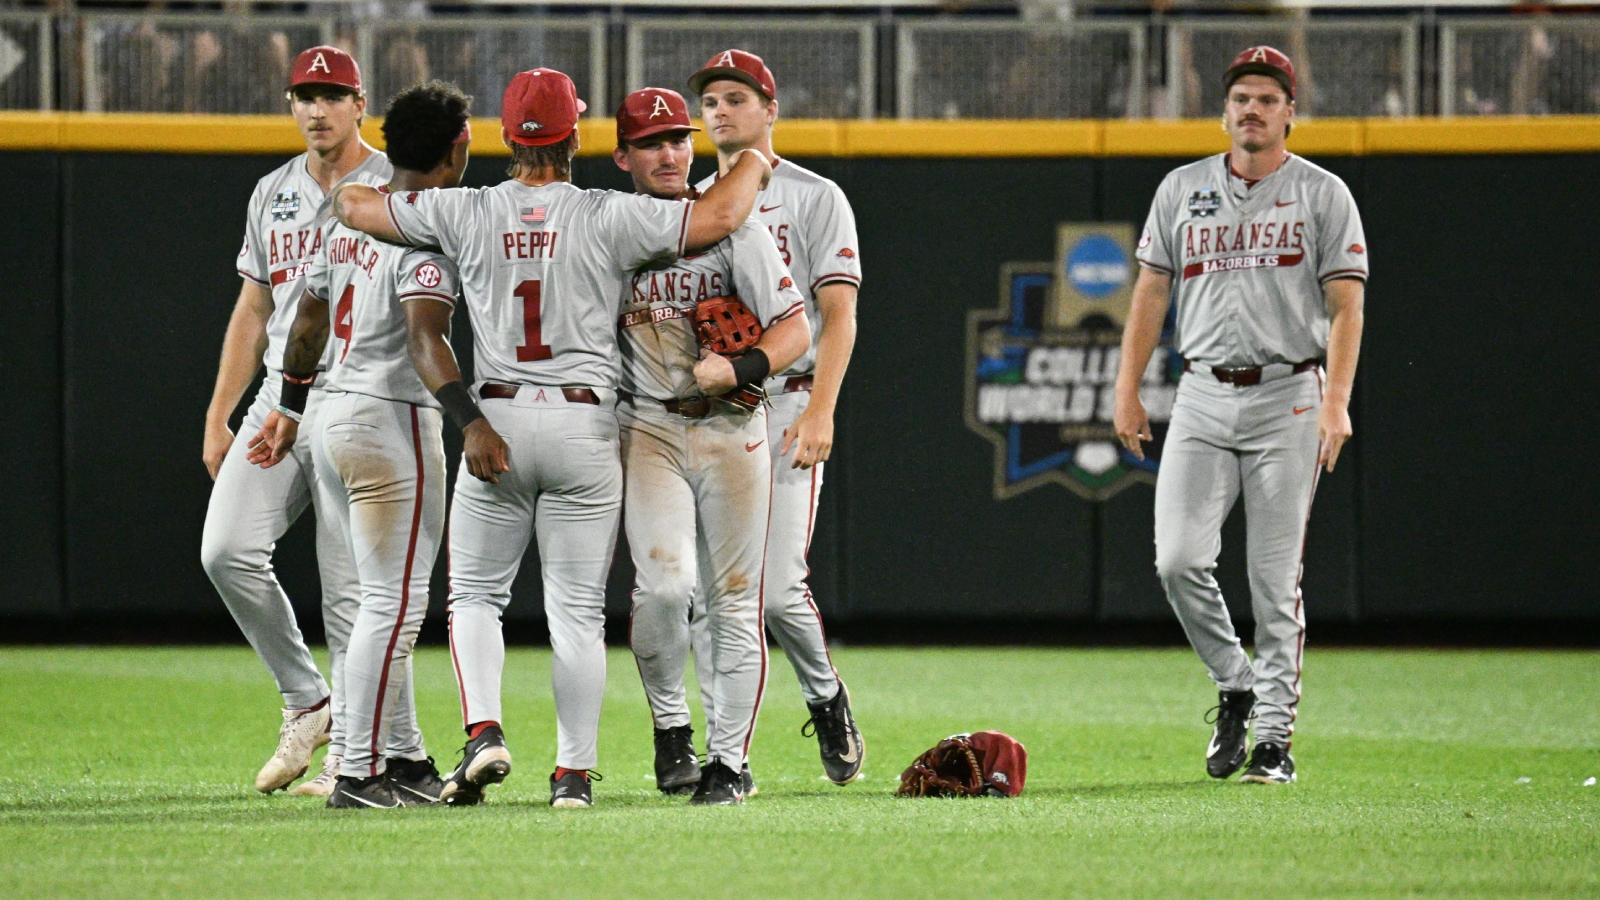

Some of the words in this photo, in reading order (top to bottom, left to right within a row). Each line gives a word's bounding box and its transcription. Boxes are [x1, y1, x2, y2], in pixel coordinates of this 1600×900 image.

[306, 52, 331, 75] A
[714, 50, 736, 68] A
[1248, 46, 1267, 63] A
[649, 94, 674, 120] A
[269, 227, 322, 266] ARKA
[503, 231, 558, 260] PEPPI
[1186, 221, 1305, 258] ARKANSAS
[416, 264, 441, 288] SEC
[1202, 254, 1280, 274] RAZORBACKS
[625, 271, 723, 304] KANSAS
[334, 283, 355, 365] 4
[513, 279, 553, 362] 1
[1026, 348, 1169, 385] COLLEE
[534, 388, 548, 402] A
